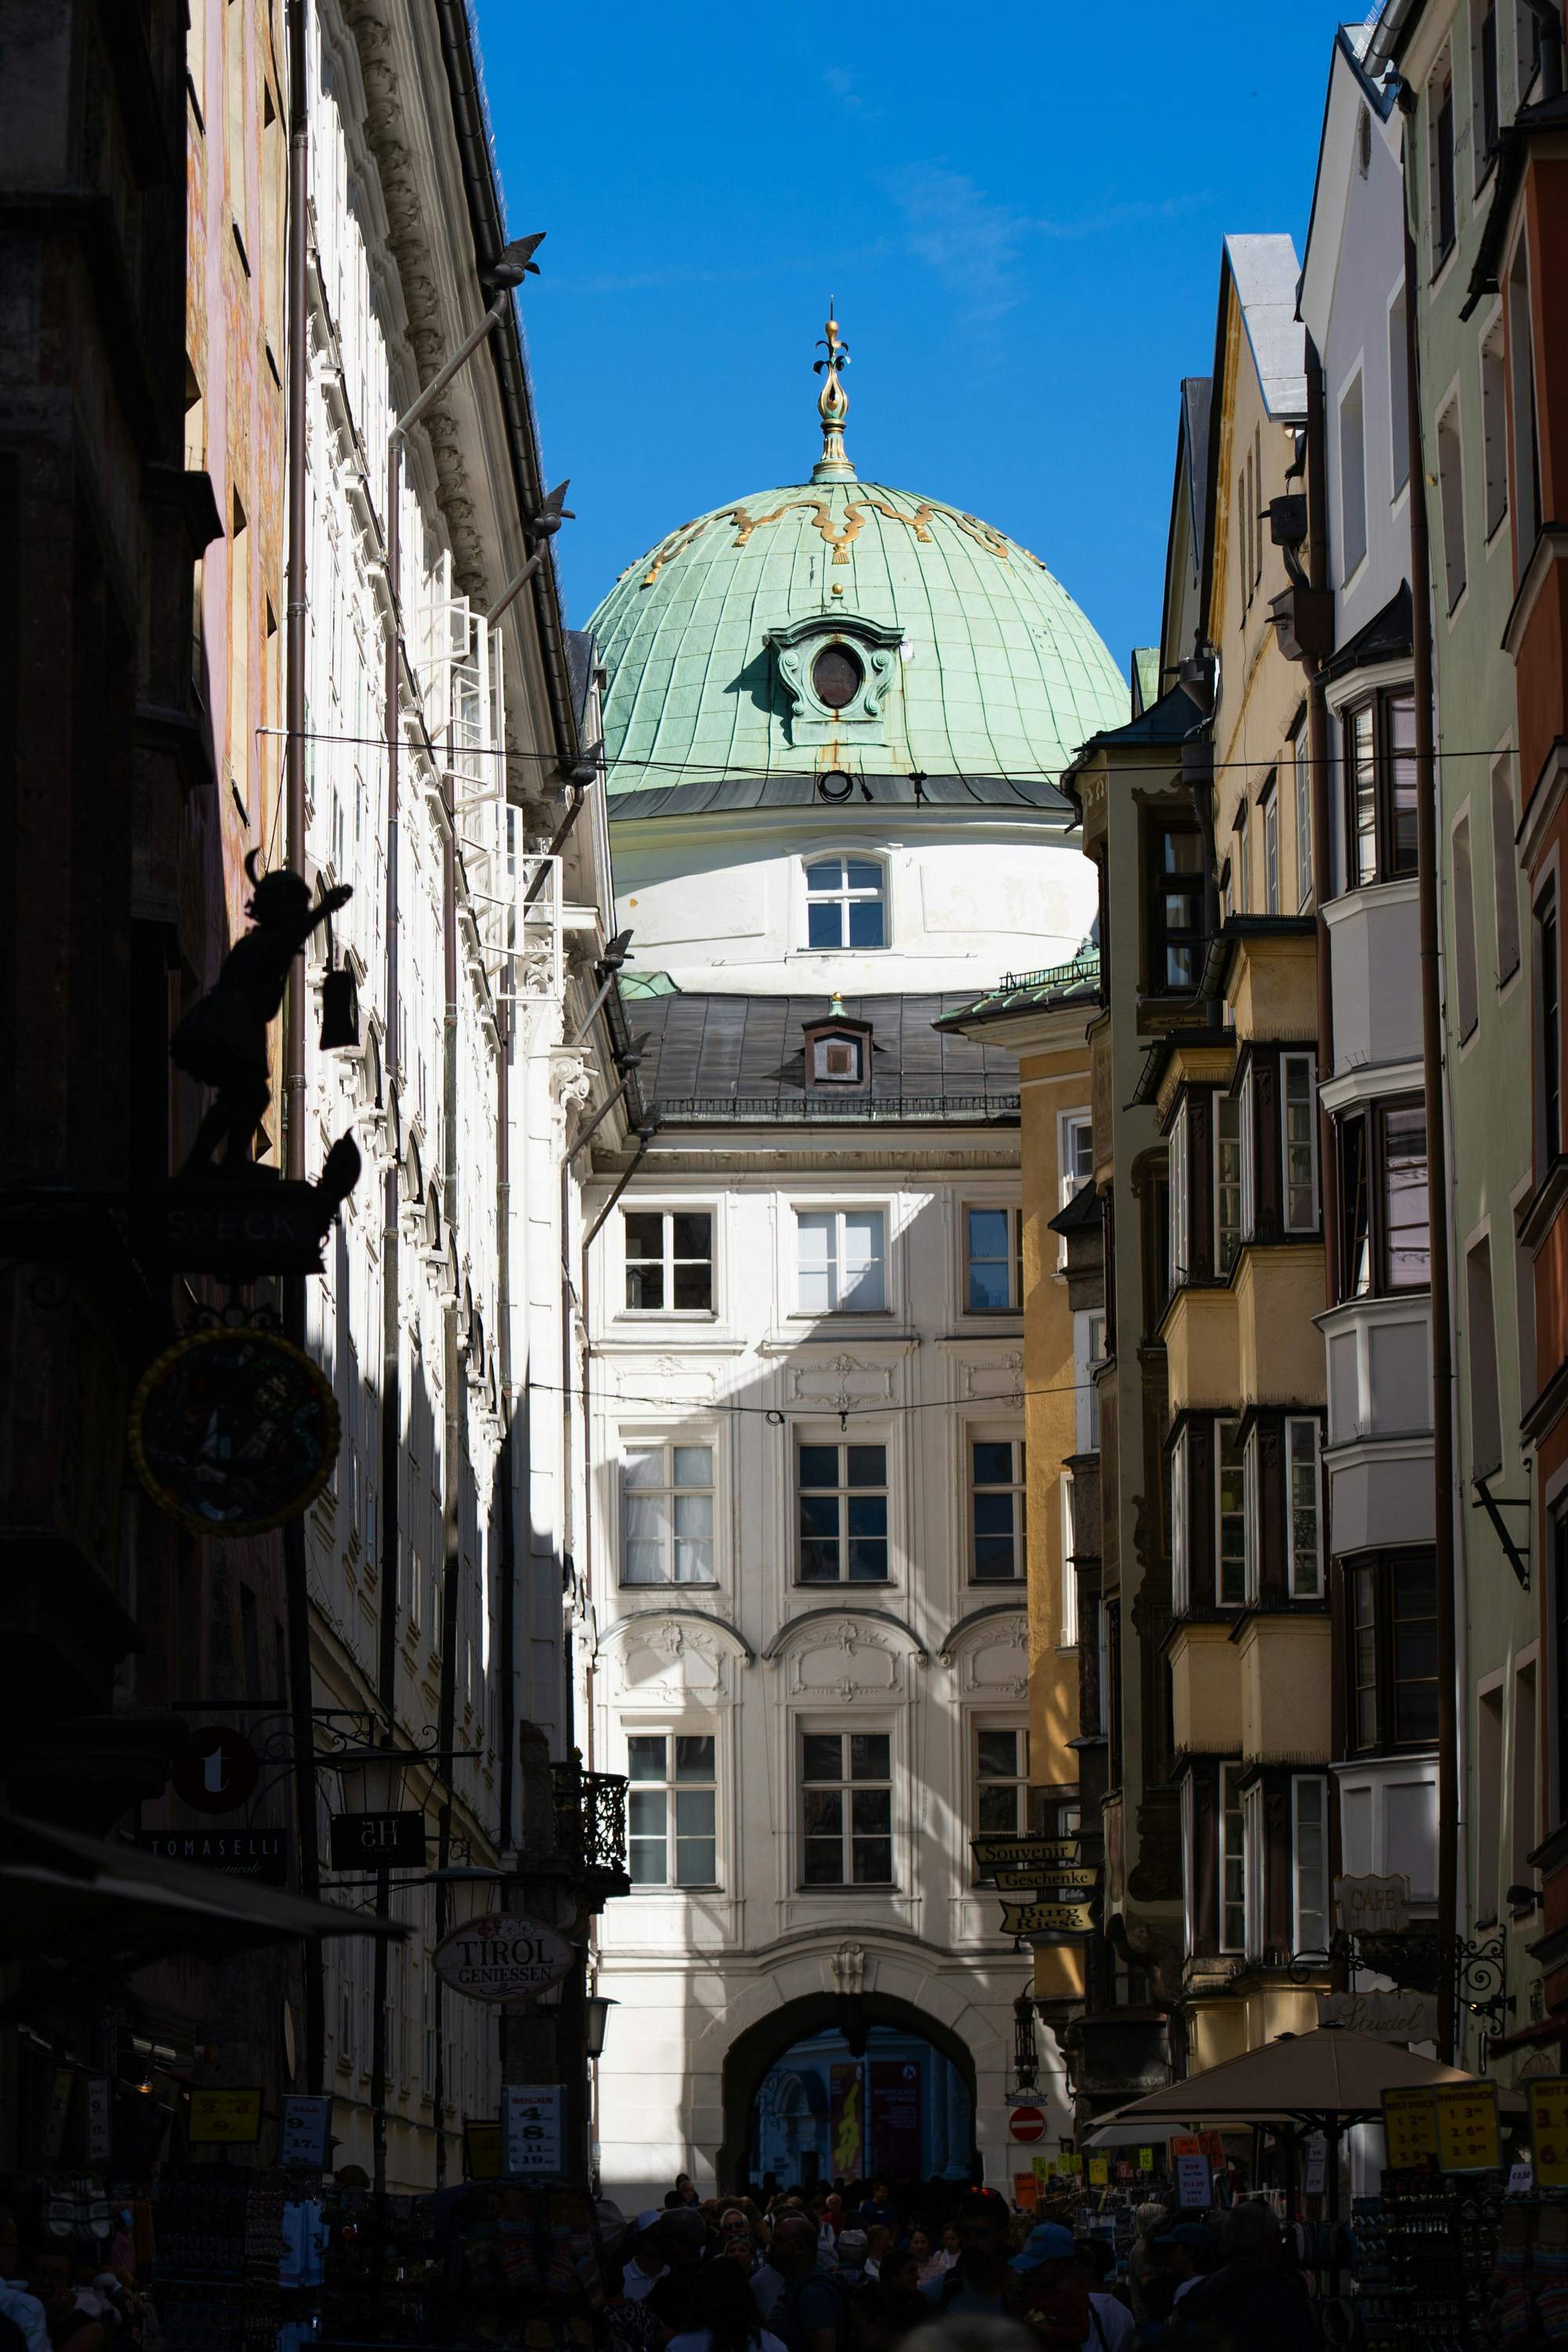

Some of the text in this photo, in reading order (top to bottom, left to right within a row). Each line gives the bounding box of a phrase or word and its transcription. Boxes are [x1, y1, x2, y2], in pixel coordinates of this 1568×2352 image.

[168, 1210, 296, 1240] SPECK
[201, 1744, 230, 1794] t
[151, 1838, 279, 1857] TOMASELLI
[985, 1842, 1069, 1861] Souvenir
[1005, 1871, 1088, 1887] Geschenke
[1020, 1907, 1080, 1920] Burg
[1016, 1918, 1084, 1929] Riese
[456, 1938, 554, 1966] TIROL
[459, 1966, 553, 1984] GENIESSEN
[1338, 1998, 1424, 2032] Strudel
[1437, 2091, 1494, 2103] INNSBRUCK
[1536, 2086, 1563, 2096] BEST
[1387, 2102, 1406, 2111] BEST
